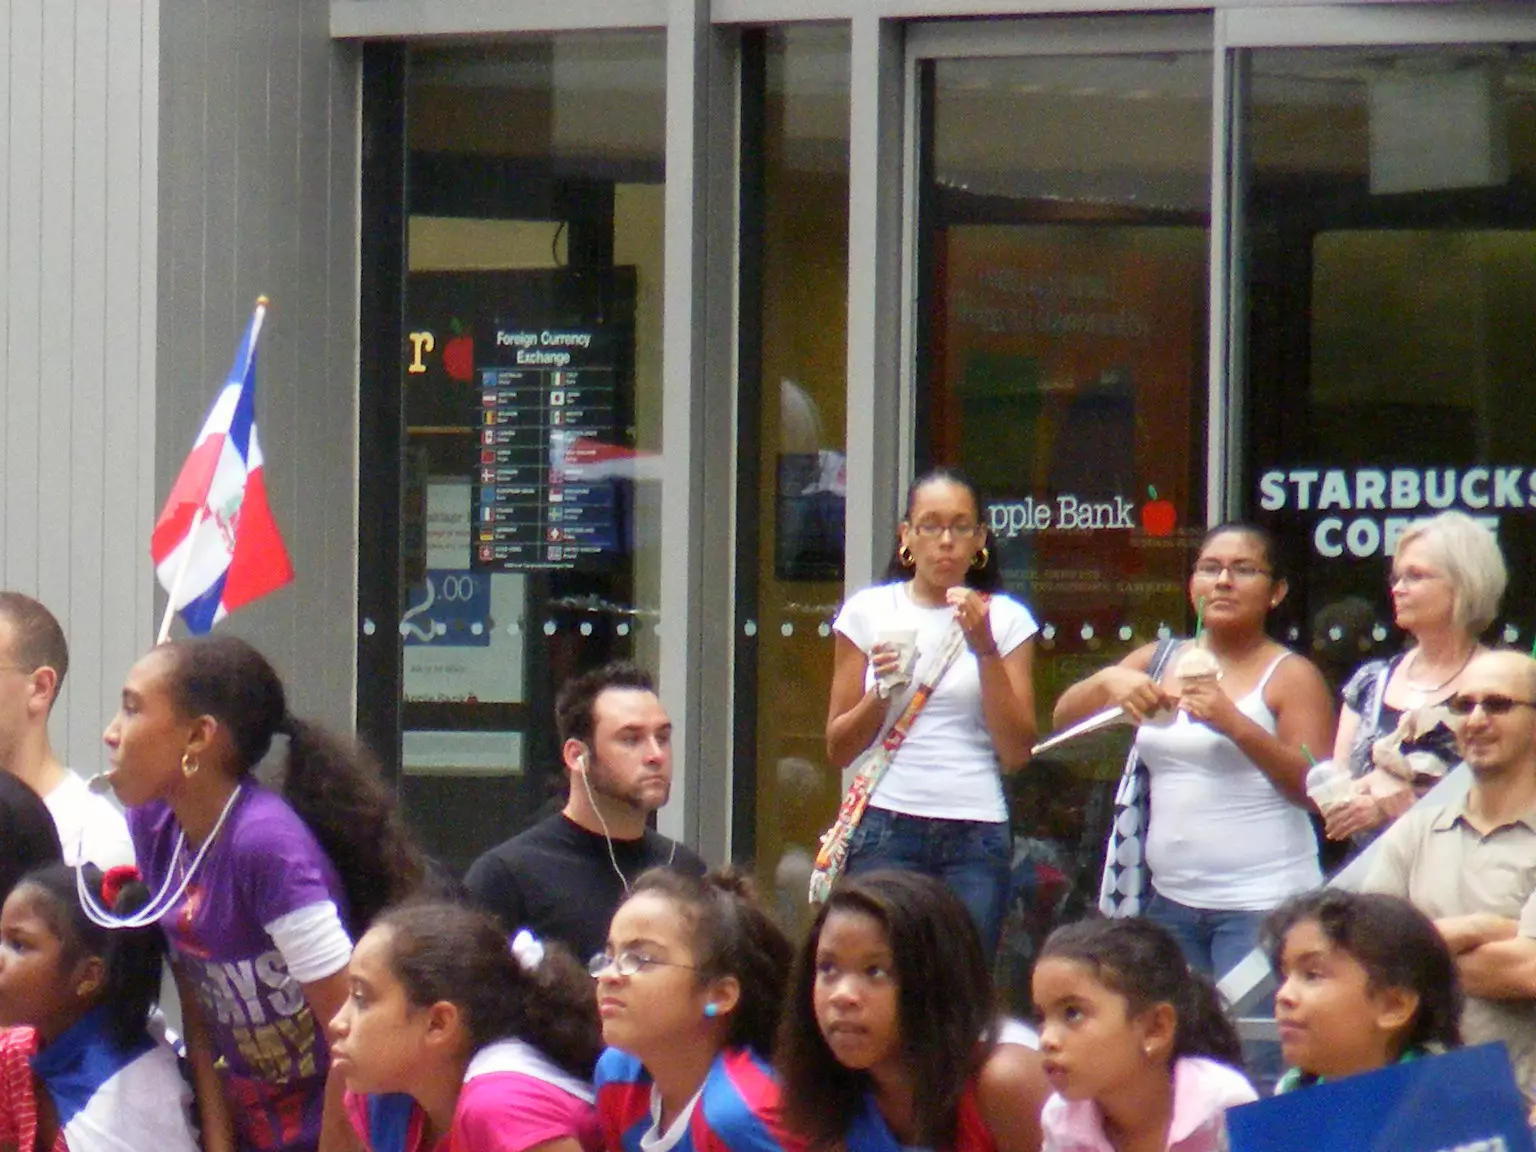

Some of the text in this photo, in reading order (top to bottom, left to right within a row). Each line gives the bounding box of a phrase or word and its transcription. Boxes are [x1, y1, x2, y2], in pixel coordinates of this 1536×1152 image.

[496, 330, 592, 348] Foreign Currency
[516, 350, 571, 367] Exchange
[987, 495, 1135, 538] pple Bank
